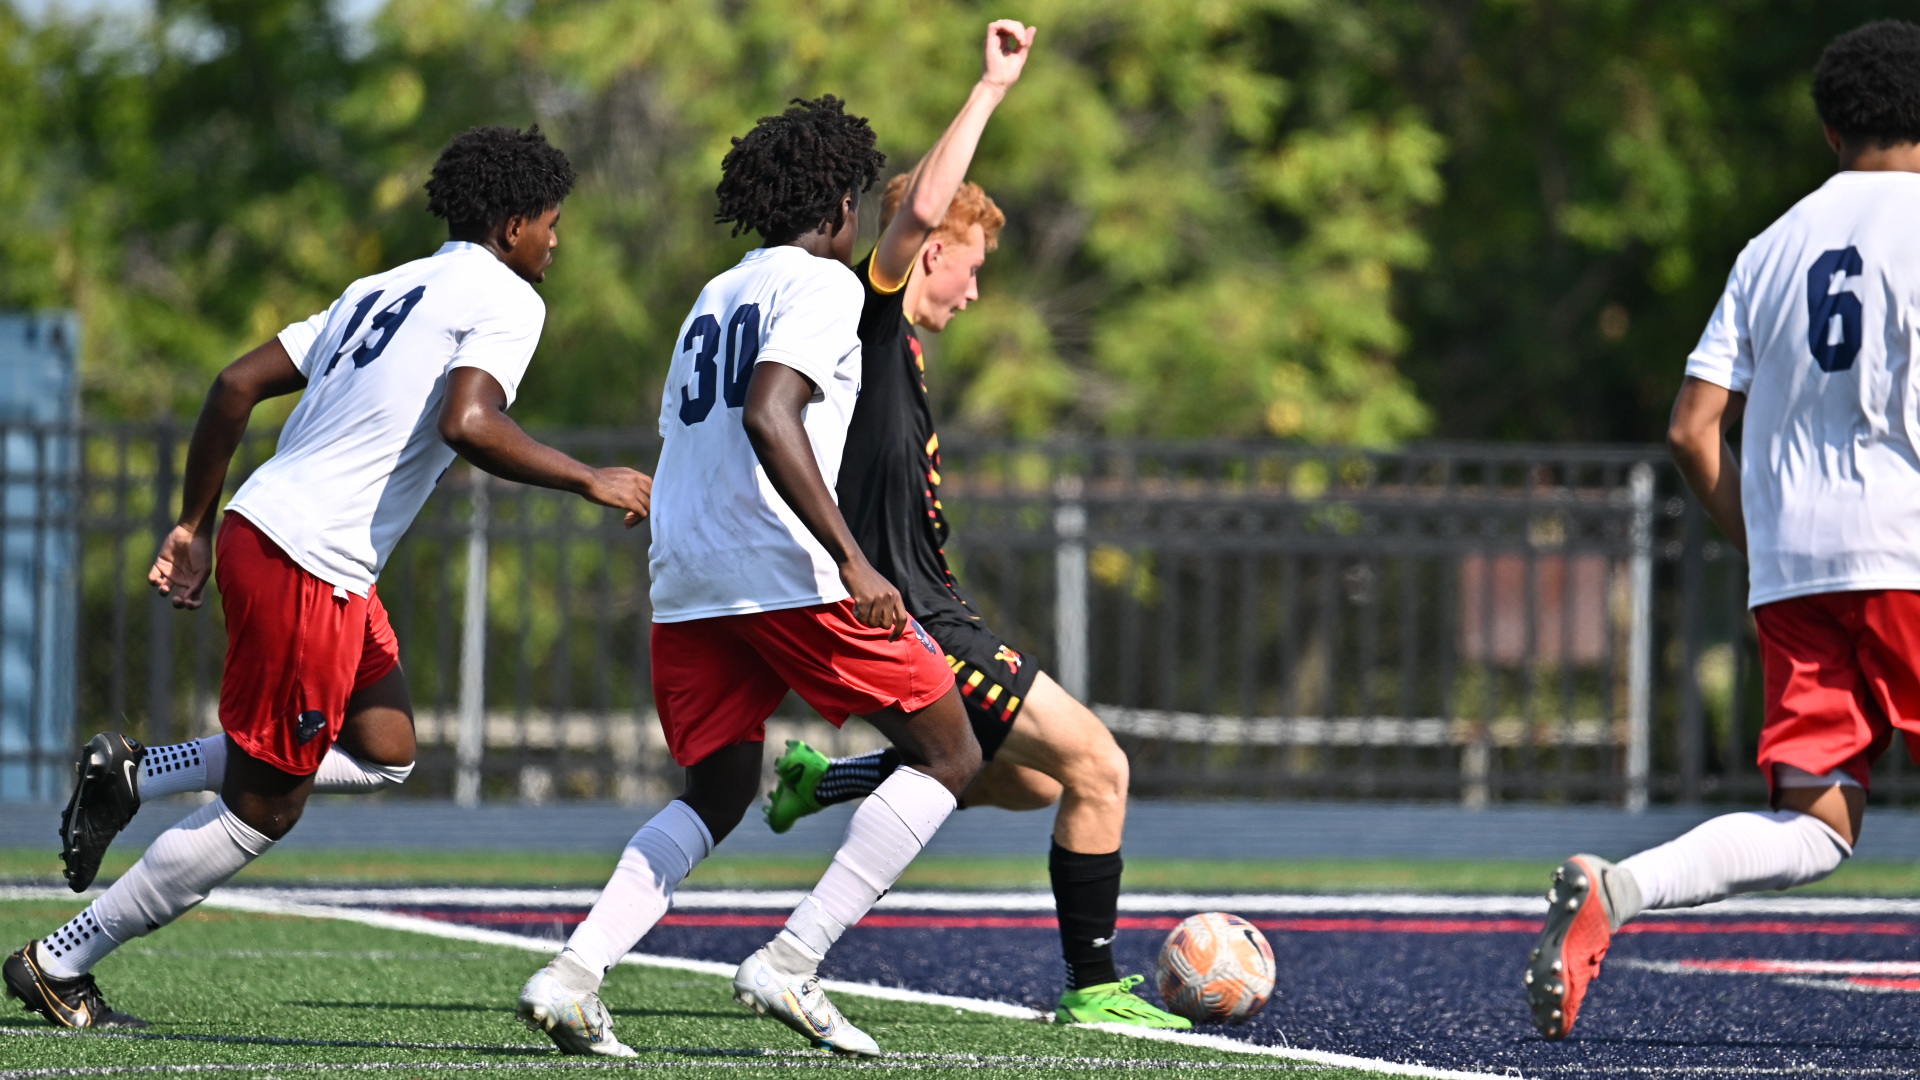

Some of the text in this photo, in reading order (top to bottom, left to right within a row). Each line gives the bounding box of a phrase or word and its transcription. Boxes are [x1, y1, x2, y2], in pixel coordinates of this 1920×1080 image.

[323, 285, 426, 377] 19
[679, 302, 761, 426] 30
[1807, 245, 1863, 373] 6
